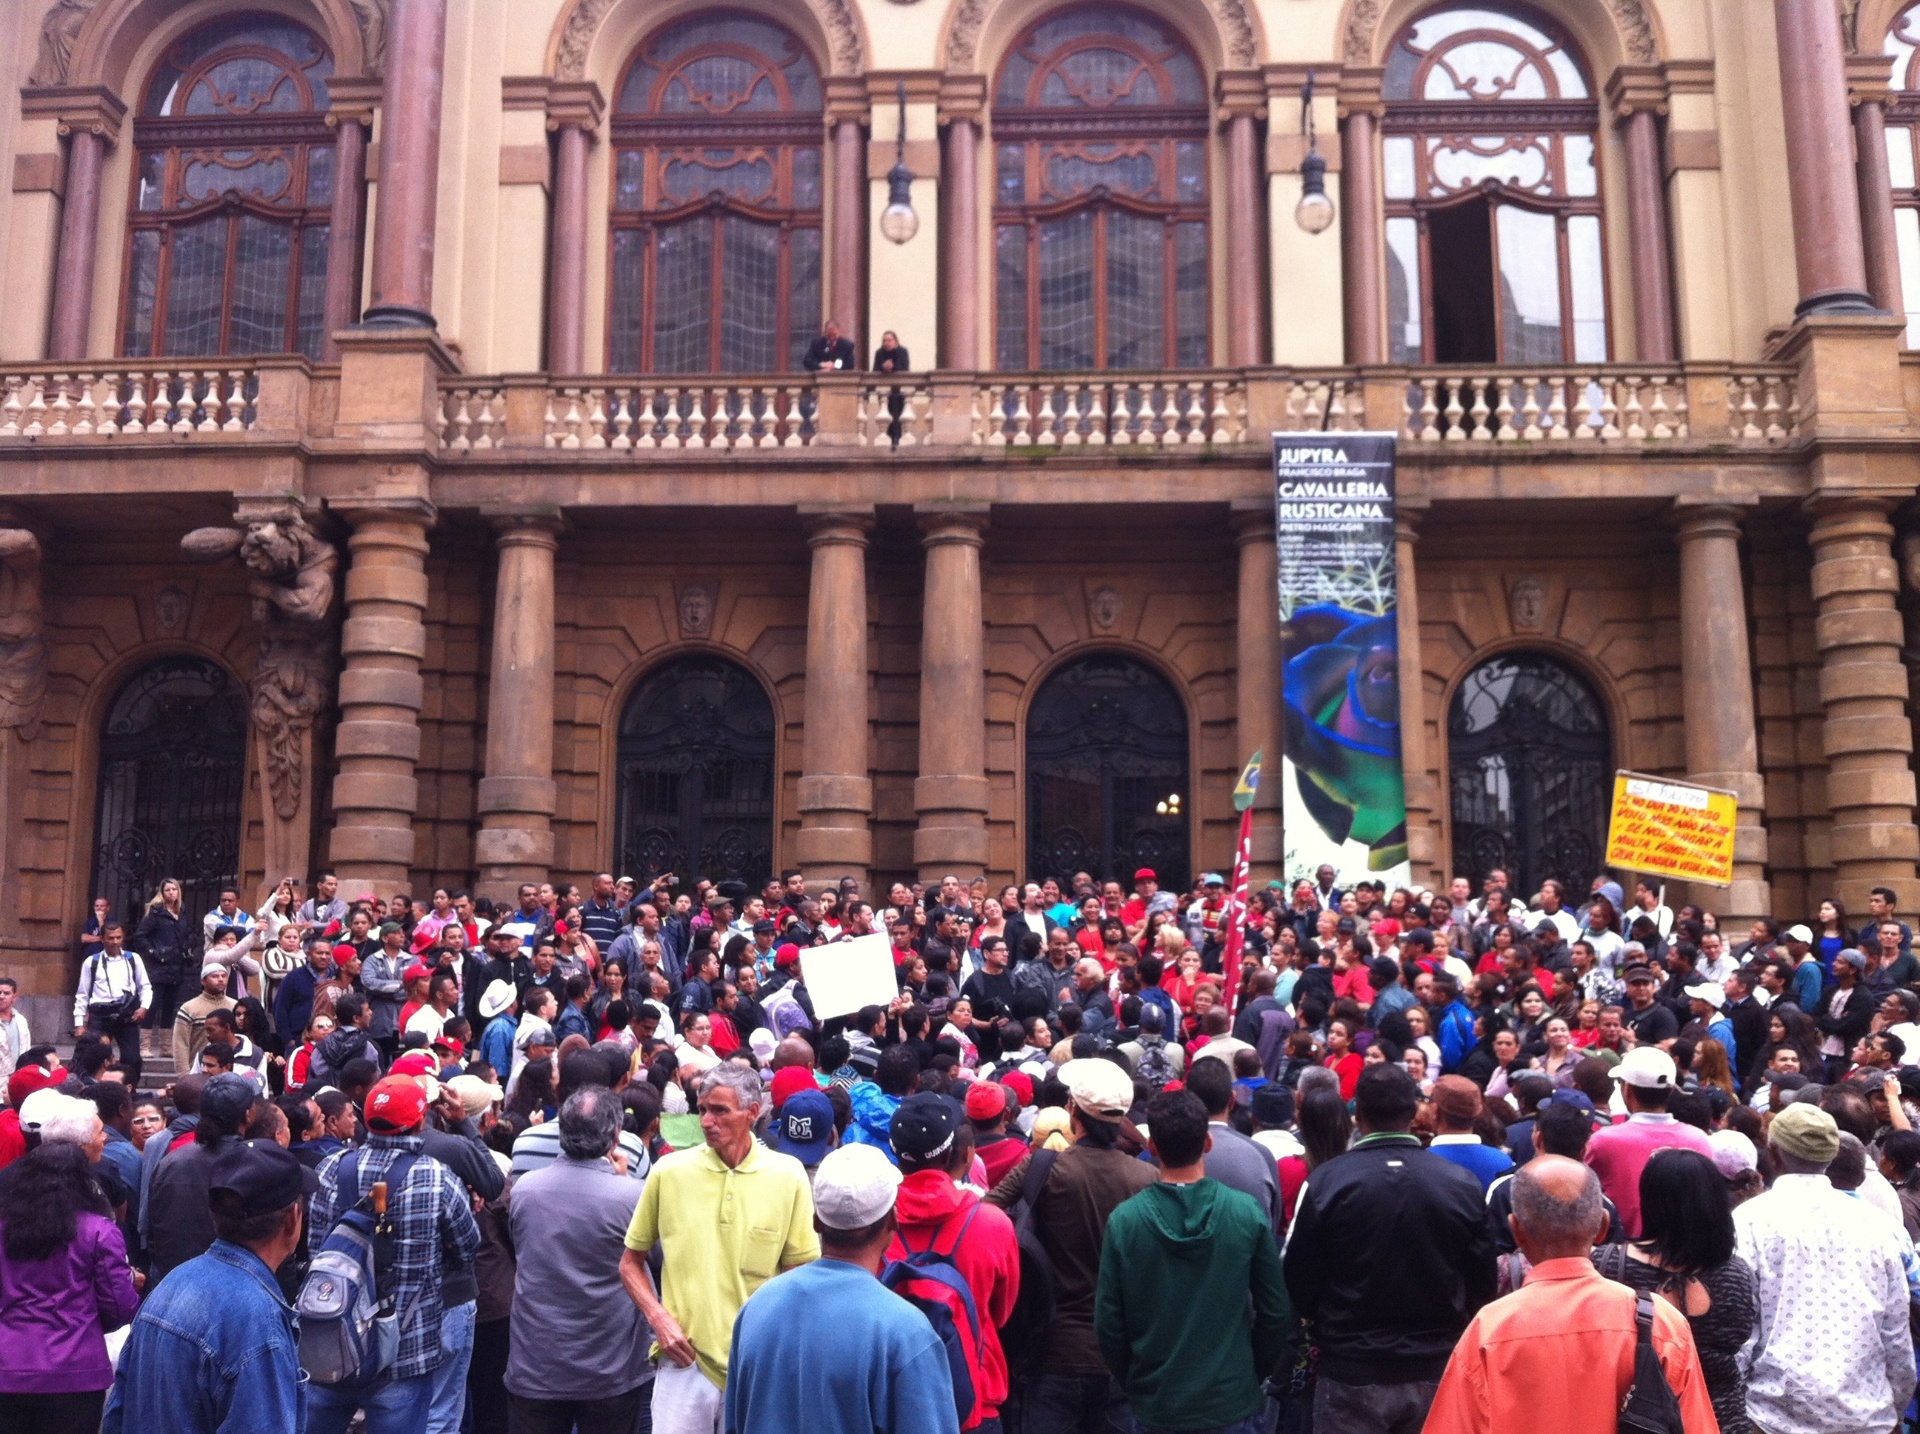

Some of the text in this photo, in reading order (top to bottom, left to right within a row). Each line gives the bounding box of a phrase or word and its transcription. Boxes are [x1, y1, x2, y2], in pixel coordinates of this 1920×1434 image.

[1279, 448, 1348, 463] JUPYRA
[1279, 468, 1367, 477] FRANCISCO BRAGA
[1279, 482, 1388, 497] CAVALLERIA
[1279, 503, 1384, 518] RUSTICANA
[1280, 523, 1364, 532] PIETRO MASCAGNI
